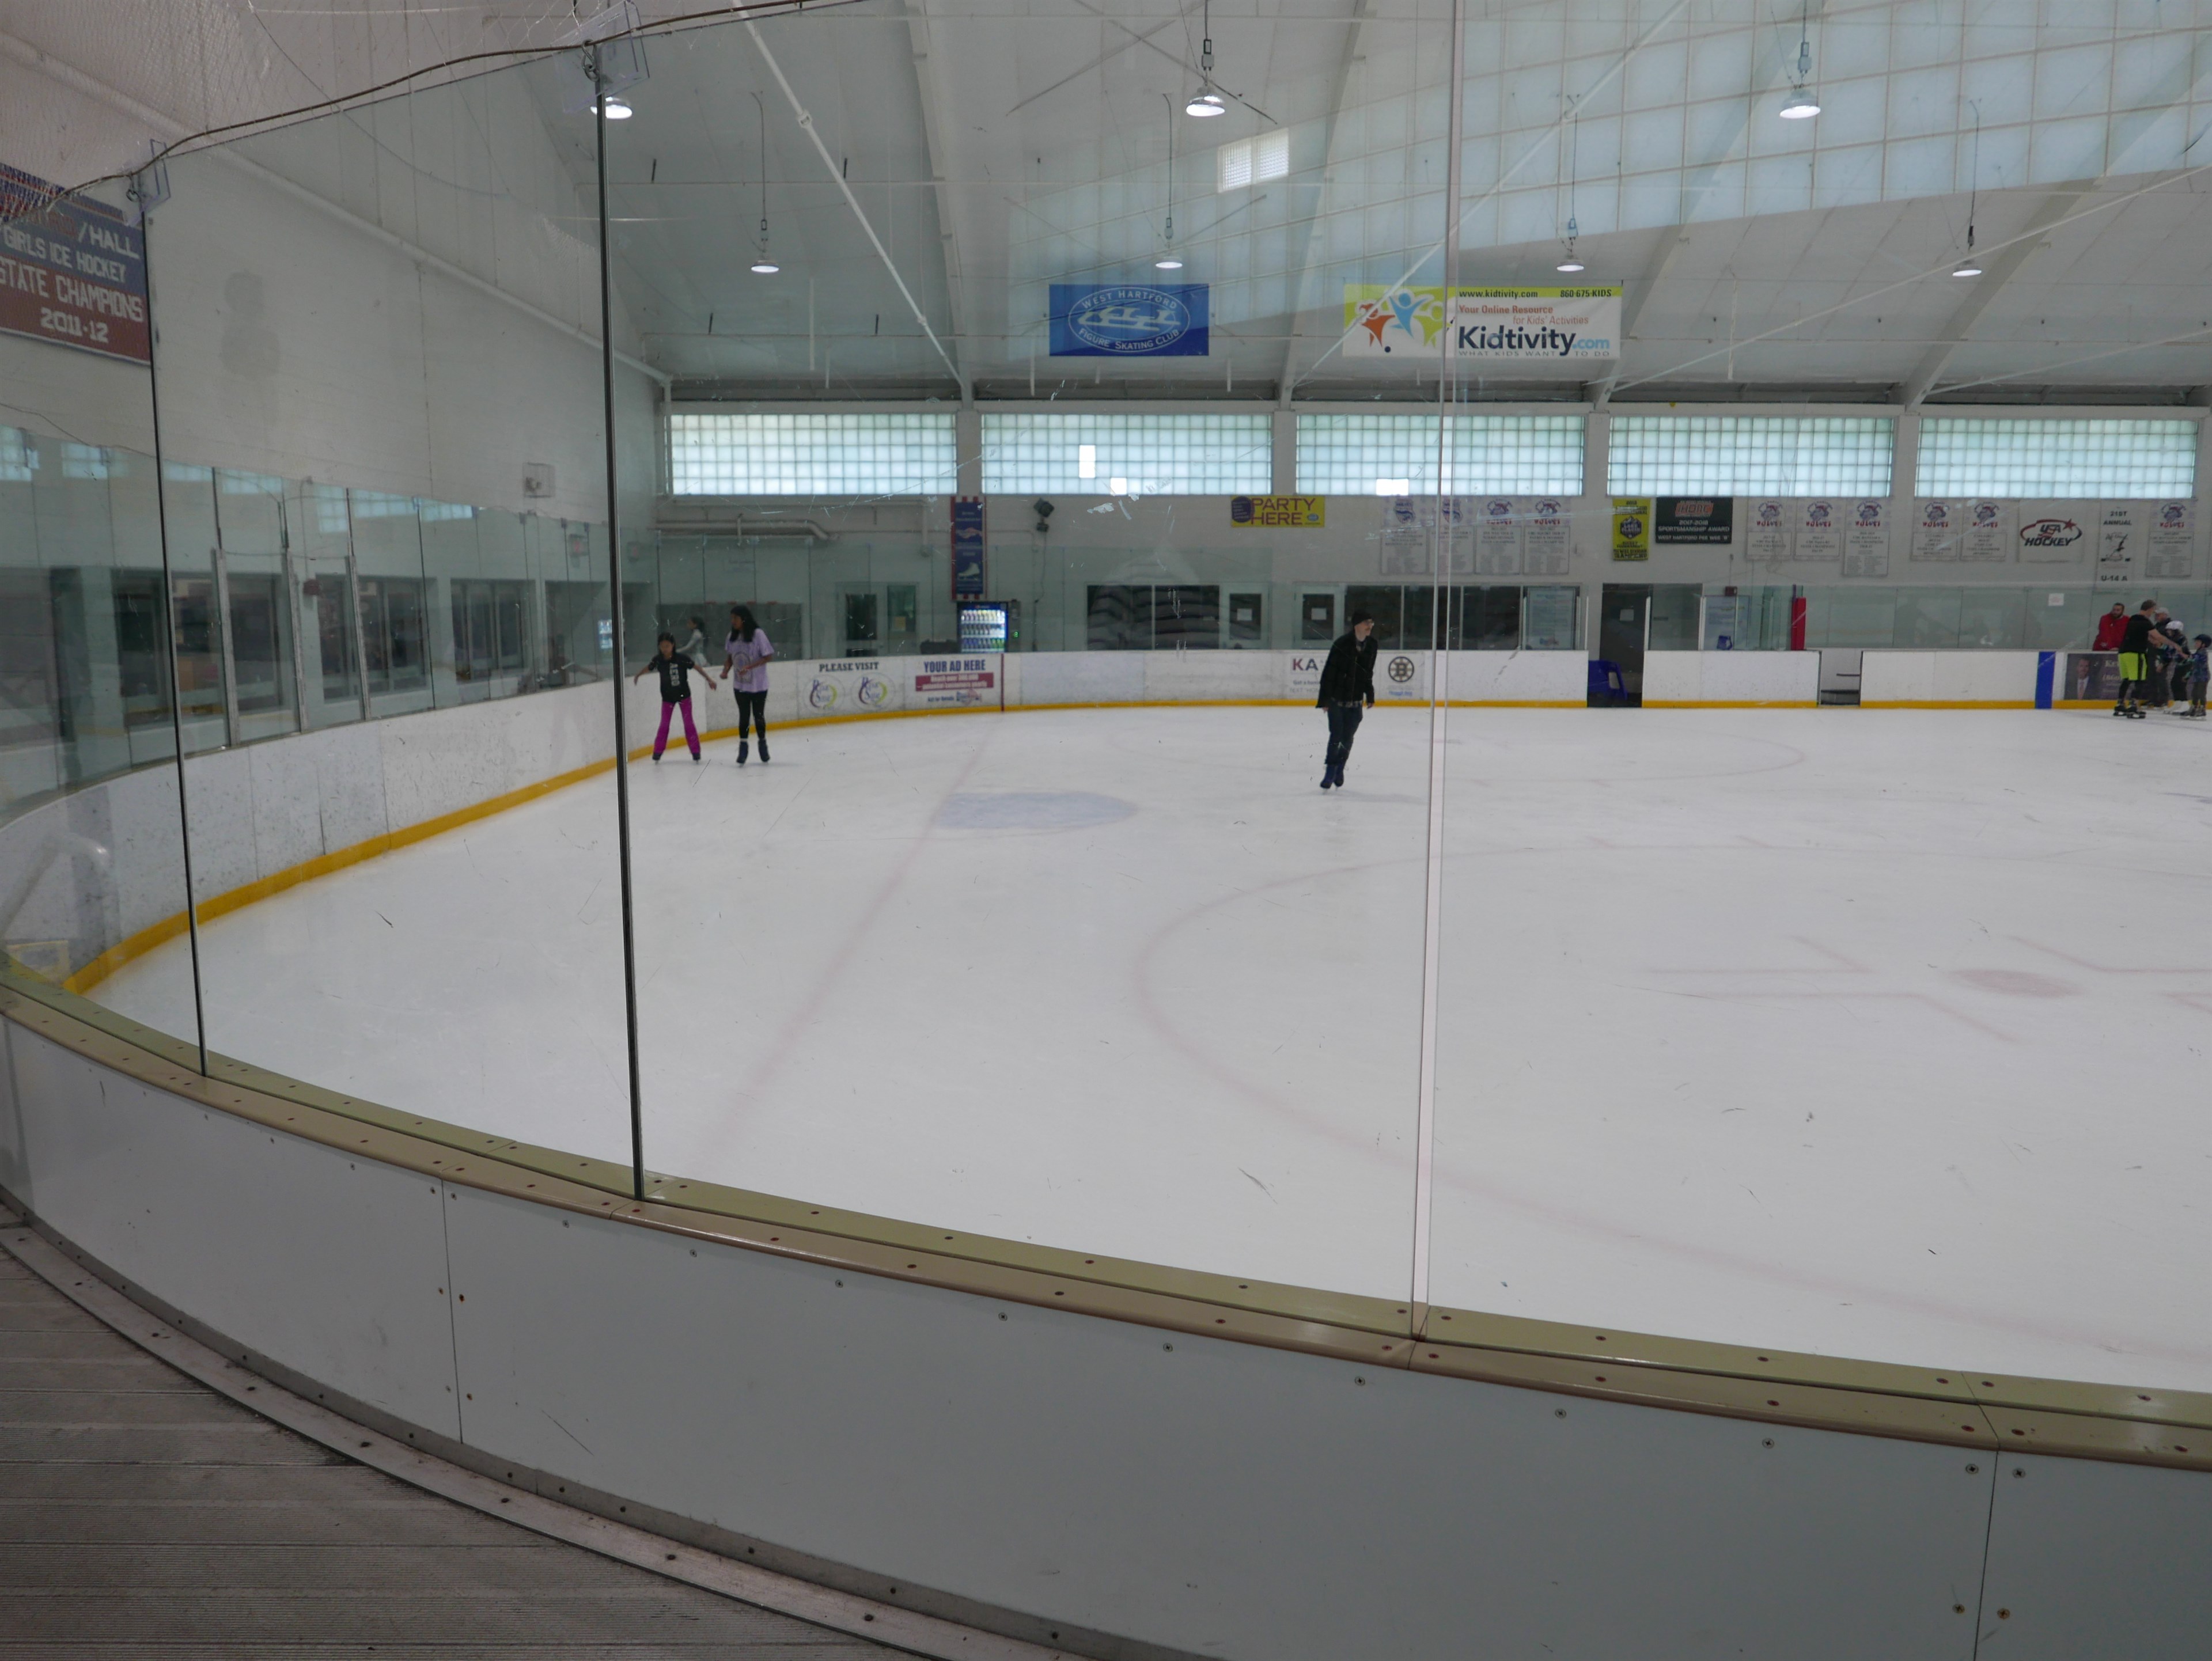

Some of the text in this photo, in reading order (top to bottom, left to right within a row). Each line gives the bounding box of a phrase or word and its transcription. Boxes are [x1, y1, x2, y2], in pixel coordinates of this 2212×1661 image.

[3, 225, 126, 282] GIRLS ICE HOCKEY
[0, 256, 144, 322] STATE CHAMPIONS
[1459, 290, 1538, 299] www.kidtivity.com
[1082, 290, 1177, 309] WEST HARTFORD
[1459, 305, 1553, 313] Your Online Resource
[1513, 316, 1589, 325] for Kids' Activities
[1078, 328, 1180, 350] FIGURE SKATING CLUB
[1251, 498, 1316, 511] PARTY
[1251, 512, 1302, 525] HERE
[2024, 538, 2073, 547] HOCKEY
[819, 662, 879, 672] PLEASE VISIT
[923, 659, 986, 673] YOUR AD HERE
